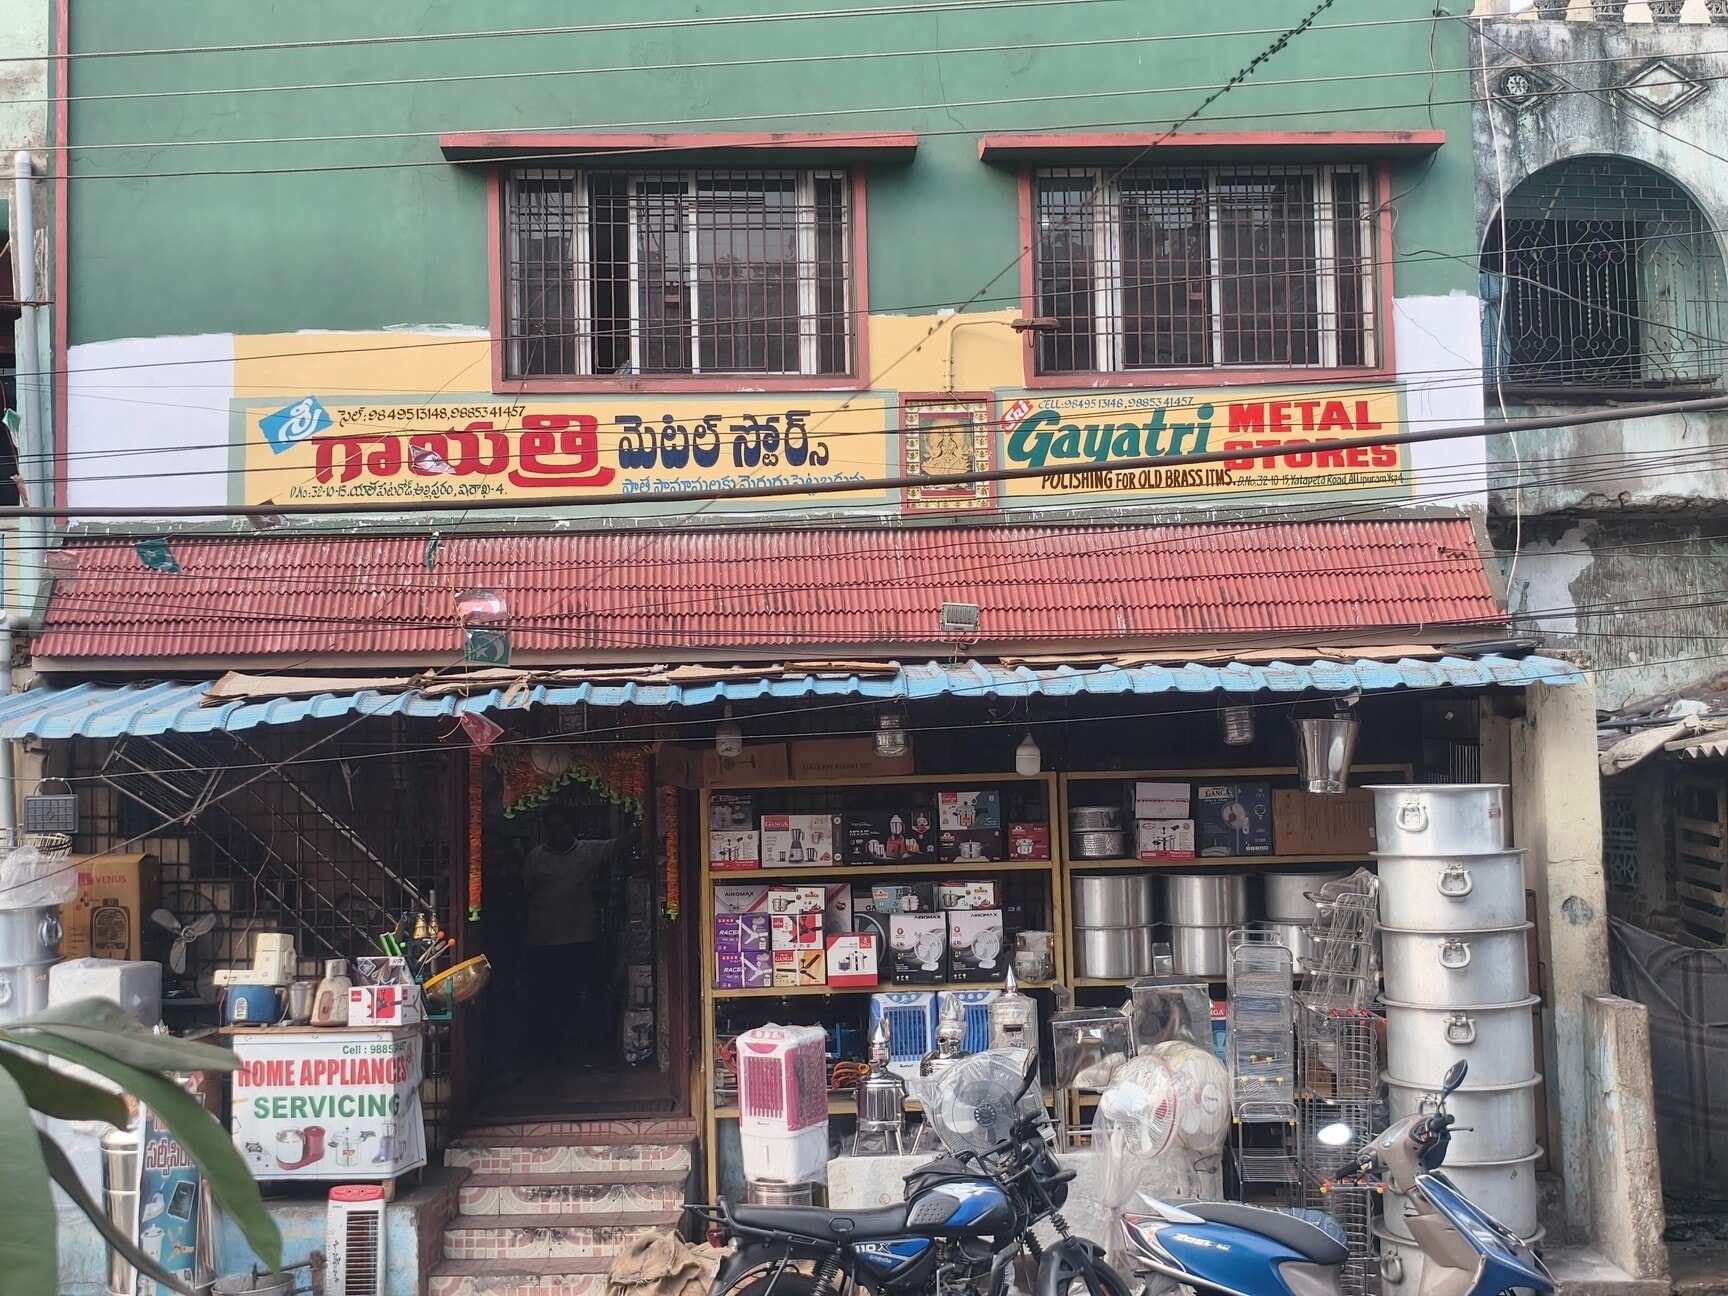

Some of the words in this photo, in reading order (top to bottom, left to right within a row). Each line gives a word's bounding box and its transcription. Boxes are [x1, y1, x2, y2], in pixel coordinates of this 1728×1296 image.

[1228, 400, 1383, 434] METAL
[1007, 402, 1215, 469] Gayatri
[1223, 437, 1398, 471] STORES
[1041, 468, 1113, 490] POLISHING
[1115, 472, 1136, 490] FOR
[1138, 469, 1163, 489] OLD
[1165, 469, 1203, 488] BRASS
[95, 874, 127, 884] VENUS
[342, 1045, 361, 1055] Cell
[237, 1059, 296, 1088] HOME
[299, 1054, 408, 1087] APPLIANCES
[253, 1092, 401, 1120] SERVICING
